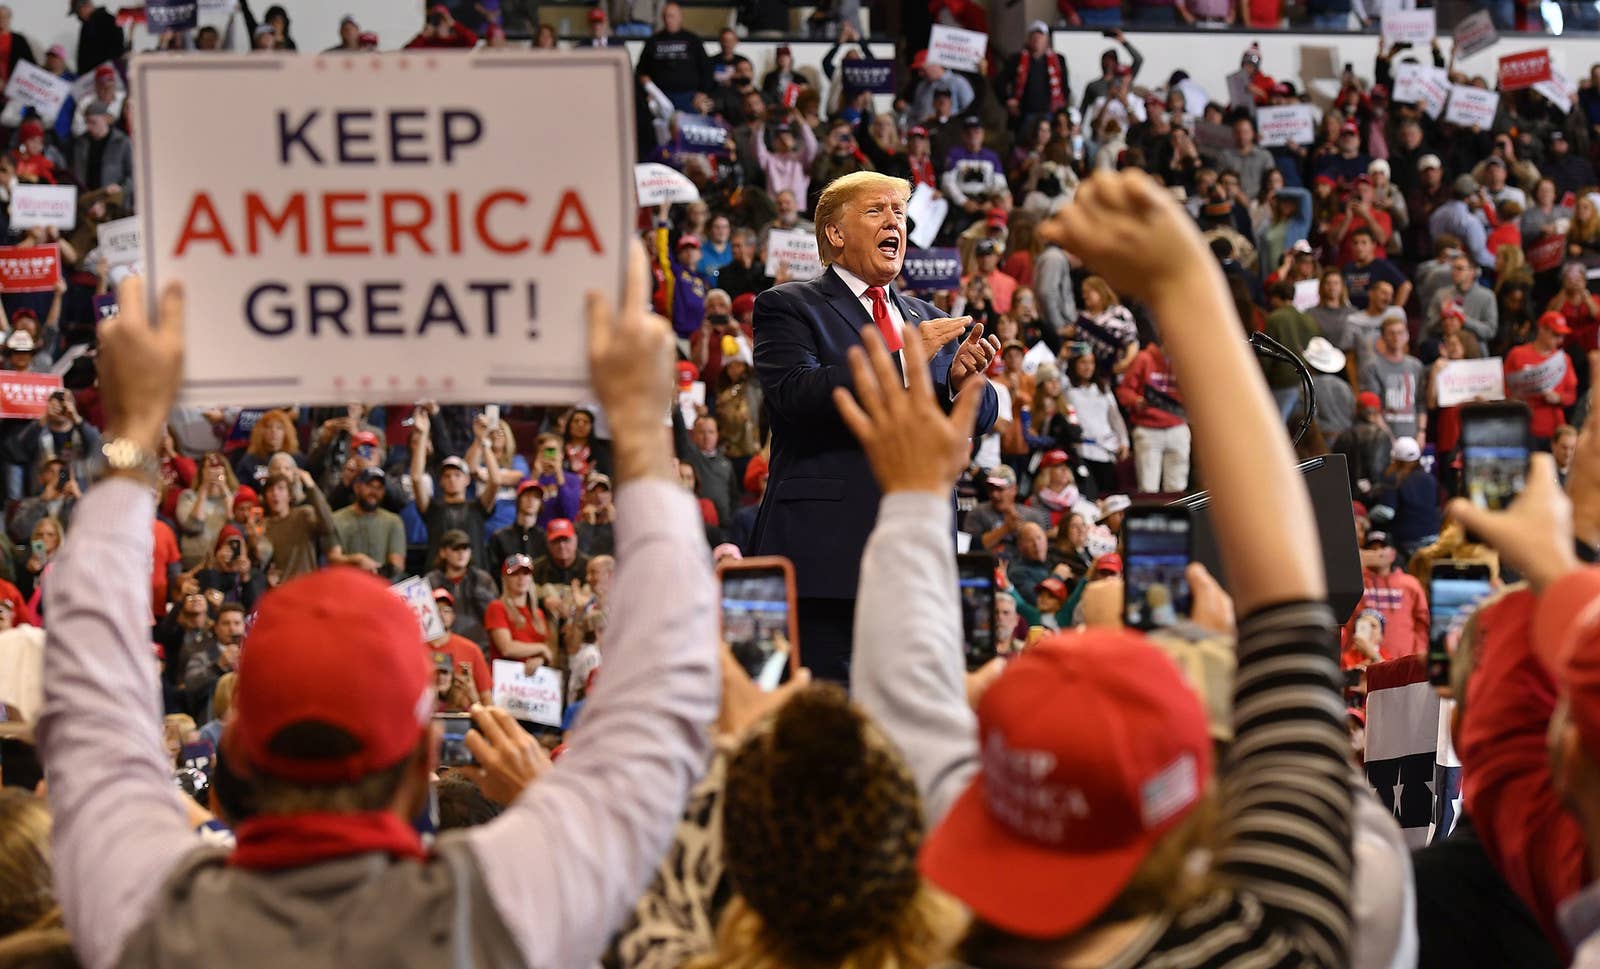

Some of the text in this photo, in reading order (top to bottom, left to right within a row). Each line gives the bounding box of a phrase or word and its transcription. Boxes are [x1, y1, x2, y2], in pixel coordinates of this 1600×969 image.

[276, 108, 484, 167] KEEP
[173, 188, 605, 258] AMERICA
[243, 281, 541, 341] GREAT!
